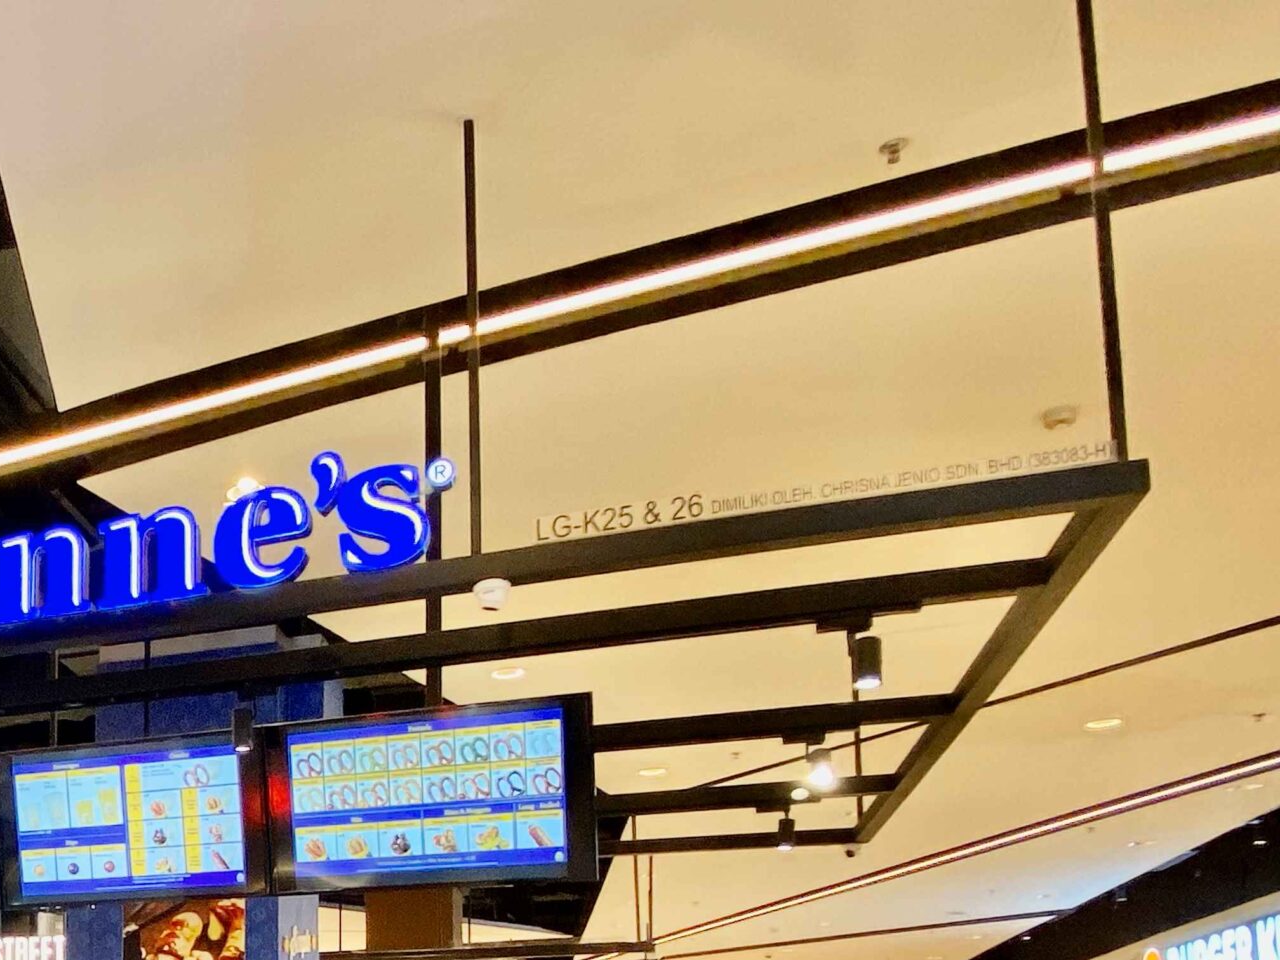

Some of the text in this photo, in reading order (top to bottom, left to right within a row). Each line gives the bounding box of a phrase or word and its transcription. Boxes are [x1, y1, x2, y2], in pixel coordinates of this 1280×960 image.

[536, 505, 634, 541] LG-K25
[642, 500, 662, 526] &
[671, 494, 704, 521] 26
